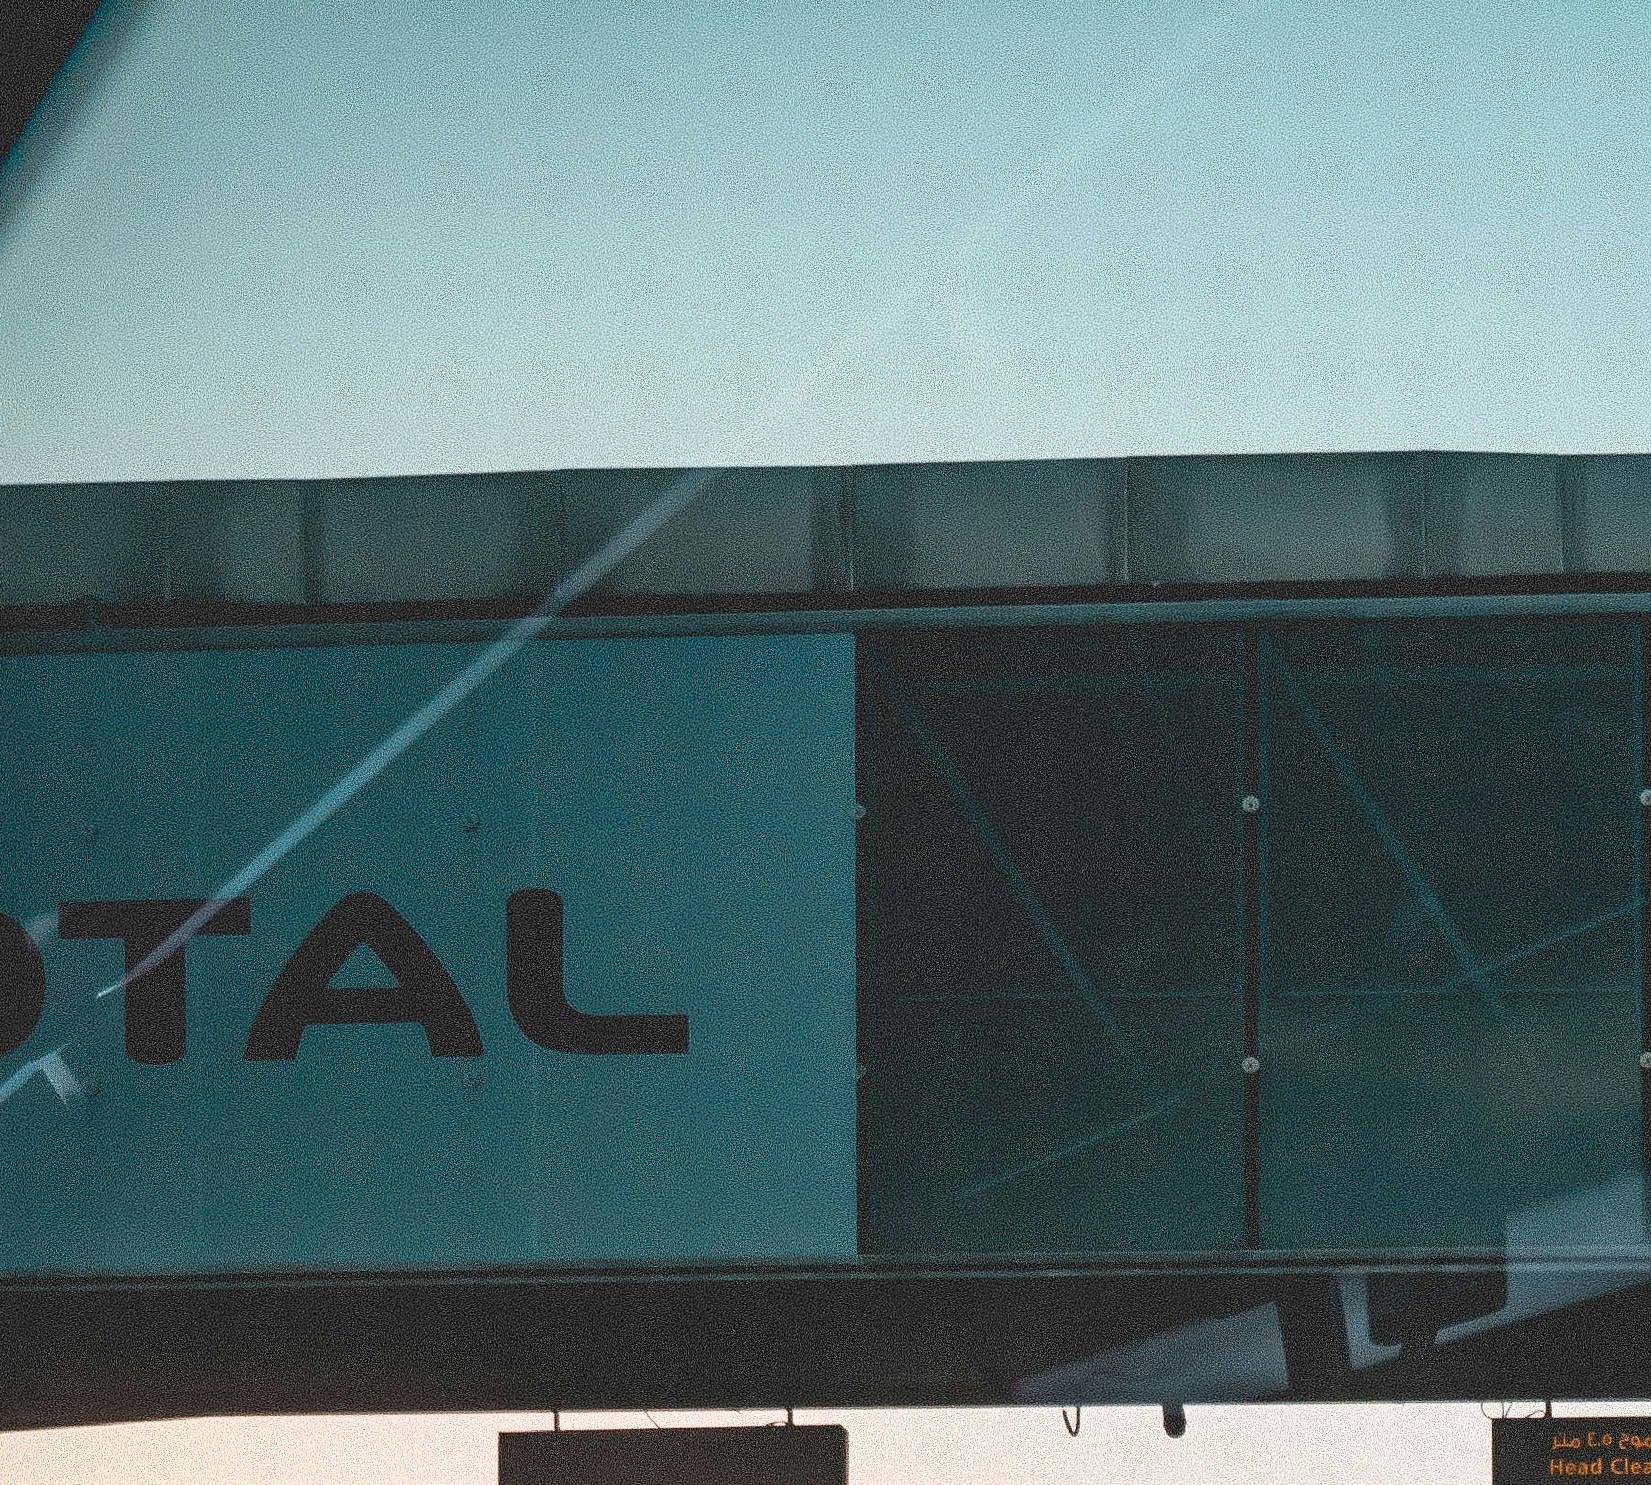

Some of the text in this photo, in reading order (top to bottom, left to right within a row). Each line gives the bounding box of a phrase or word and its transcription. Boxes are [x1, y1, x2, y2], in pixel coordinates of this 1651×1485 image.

[0, 887, 690, 1065] TAL
[1552, 1431, 1581, 1451] متر
[1550, 1457, 1602, 1475] Head
